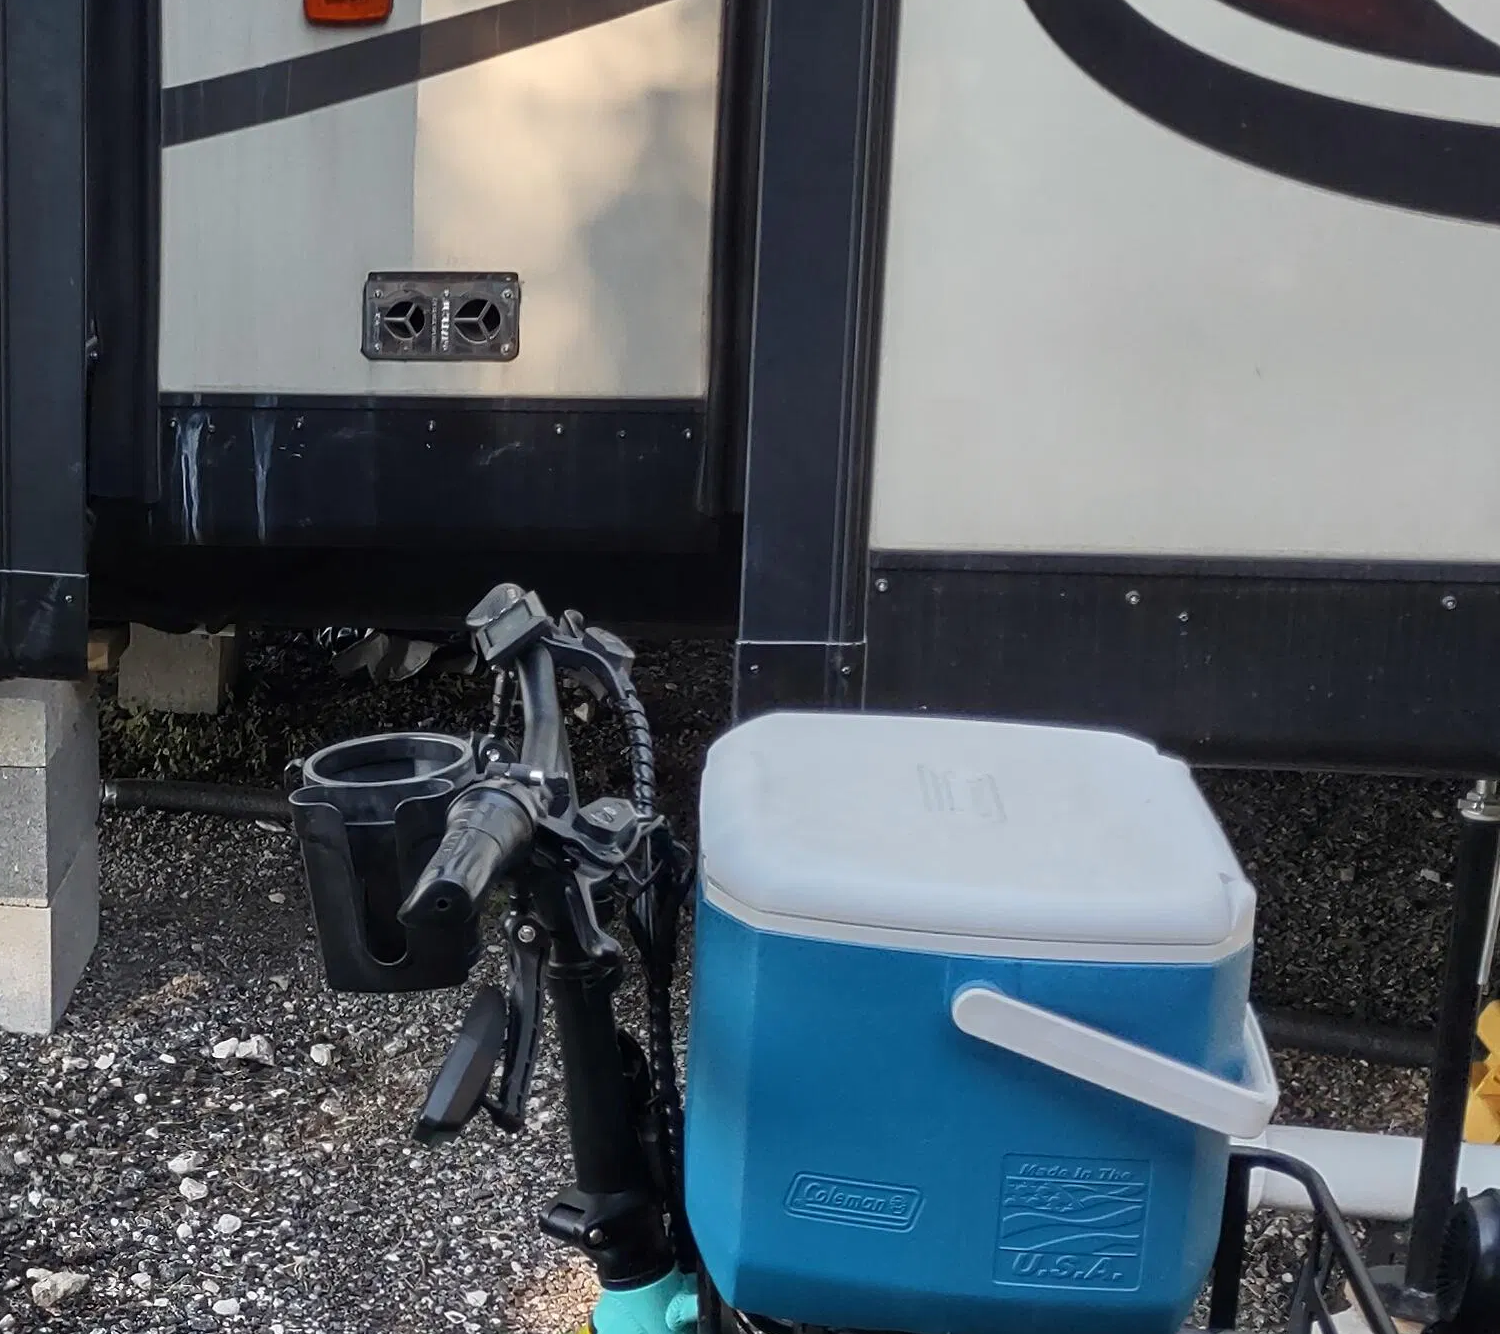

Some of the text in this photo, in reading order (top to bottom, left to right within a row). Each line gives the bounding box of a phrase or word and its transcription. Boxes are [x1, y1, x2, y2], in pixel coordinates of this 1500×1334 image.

[1019, 1163, 1132, 1180] Made In The
[803, 1181, 886, 1212] Coleman
[1011, 1252, 1124, 1280] U.S.A.
